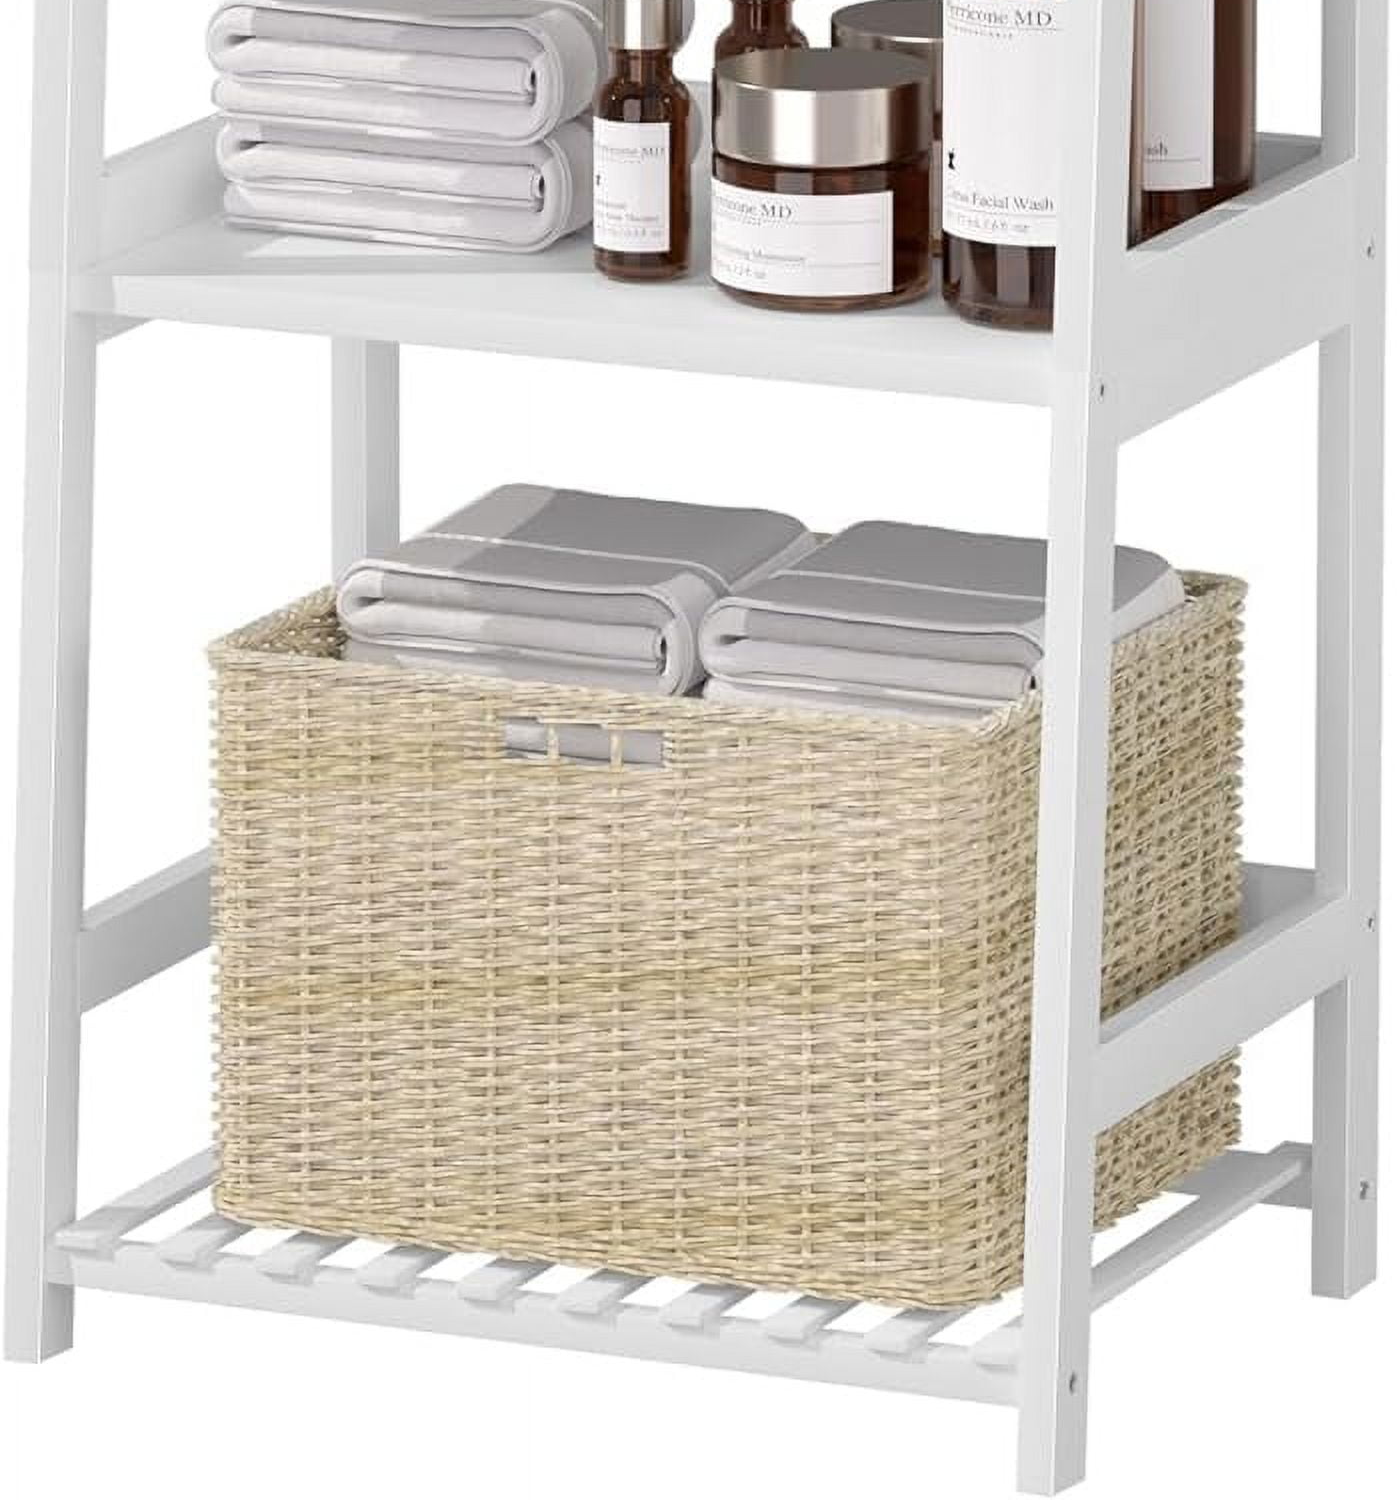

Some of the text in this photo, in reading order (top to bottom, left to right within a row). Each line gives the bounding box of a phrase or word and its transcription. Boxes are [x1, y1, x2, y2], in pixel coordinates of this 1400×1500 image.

[1014, 10, 1053, 27] MD
[972, 192, 1009, 210] Facial
[1013, 195, 1054, 212] Wash
[760, 203, 792, 219] MD
